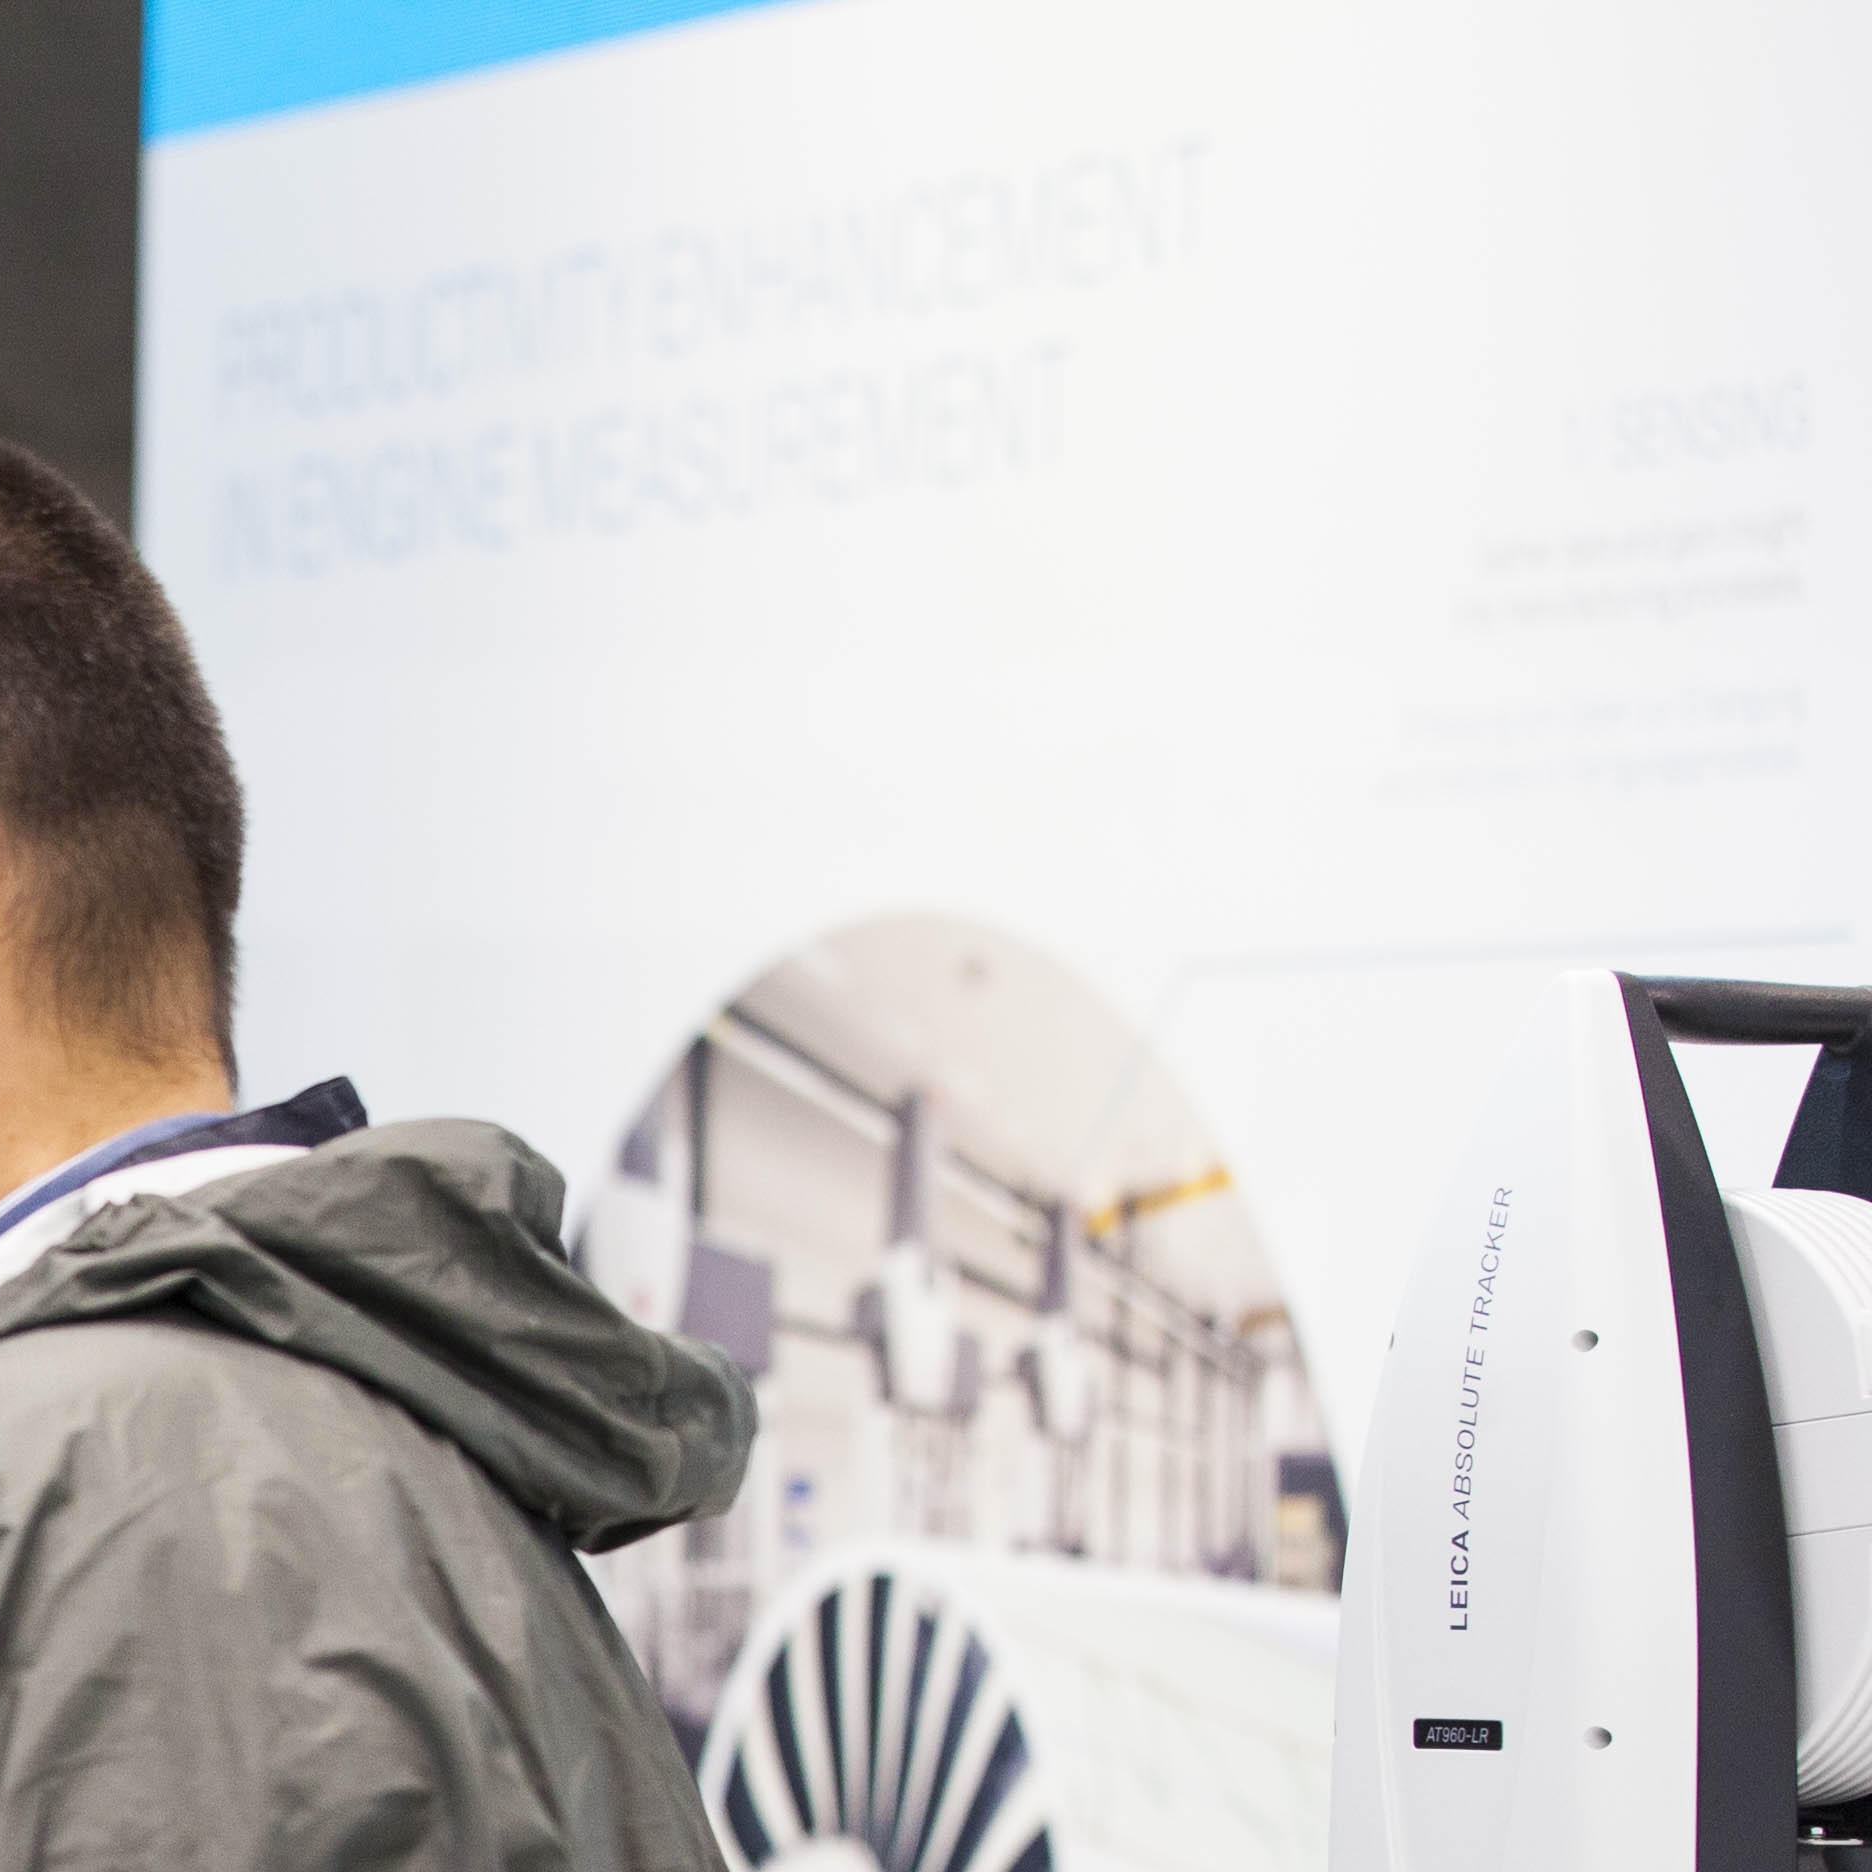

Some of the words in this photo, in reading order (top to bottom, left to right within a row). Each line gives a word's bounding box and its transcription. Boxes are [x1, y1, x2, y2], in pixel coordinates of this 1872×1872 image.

[212, 242, 630, 422] PRODUCTIVITY
[646, 129, 1216, 360] ENHANCEMENT
[212, 466, 275, 583] IN
[280, 420, 518, 579] ENGINE
[528, 333, 1076, 538] MEASUREMENT
[1469, 1185, 1514, 1334] TRACKER
[1452, 1345, 1486, 1520] ABSOLUTE
[1450, 1530, 1469, 1632] LEICA
[1425, 1726, 1490, 1744] AT960-LR
